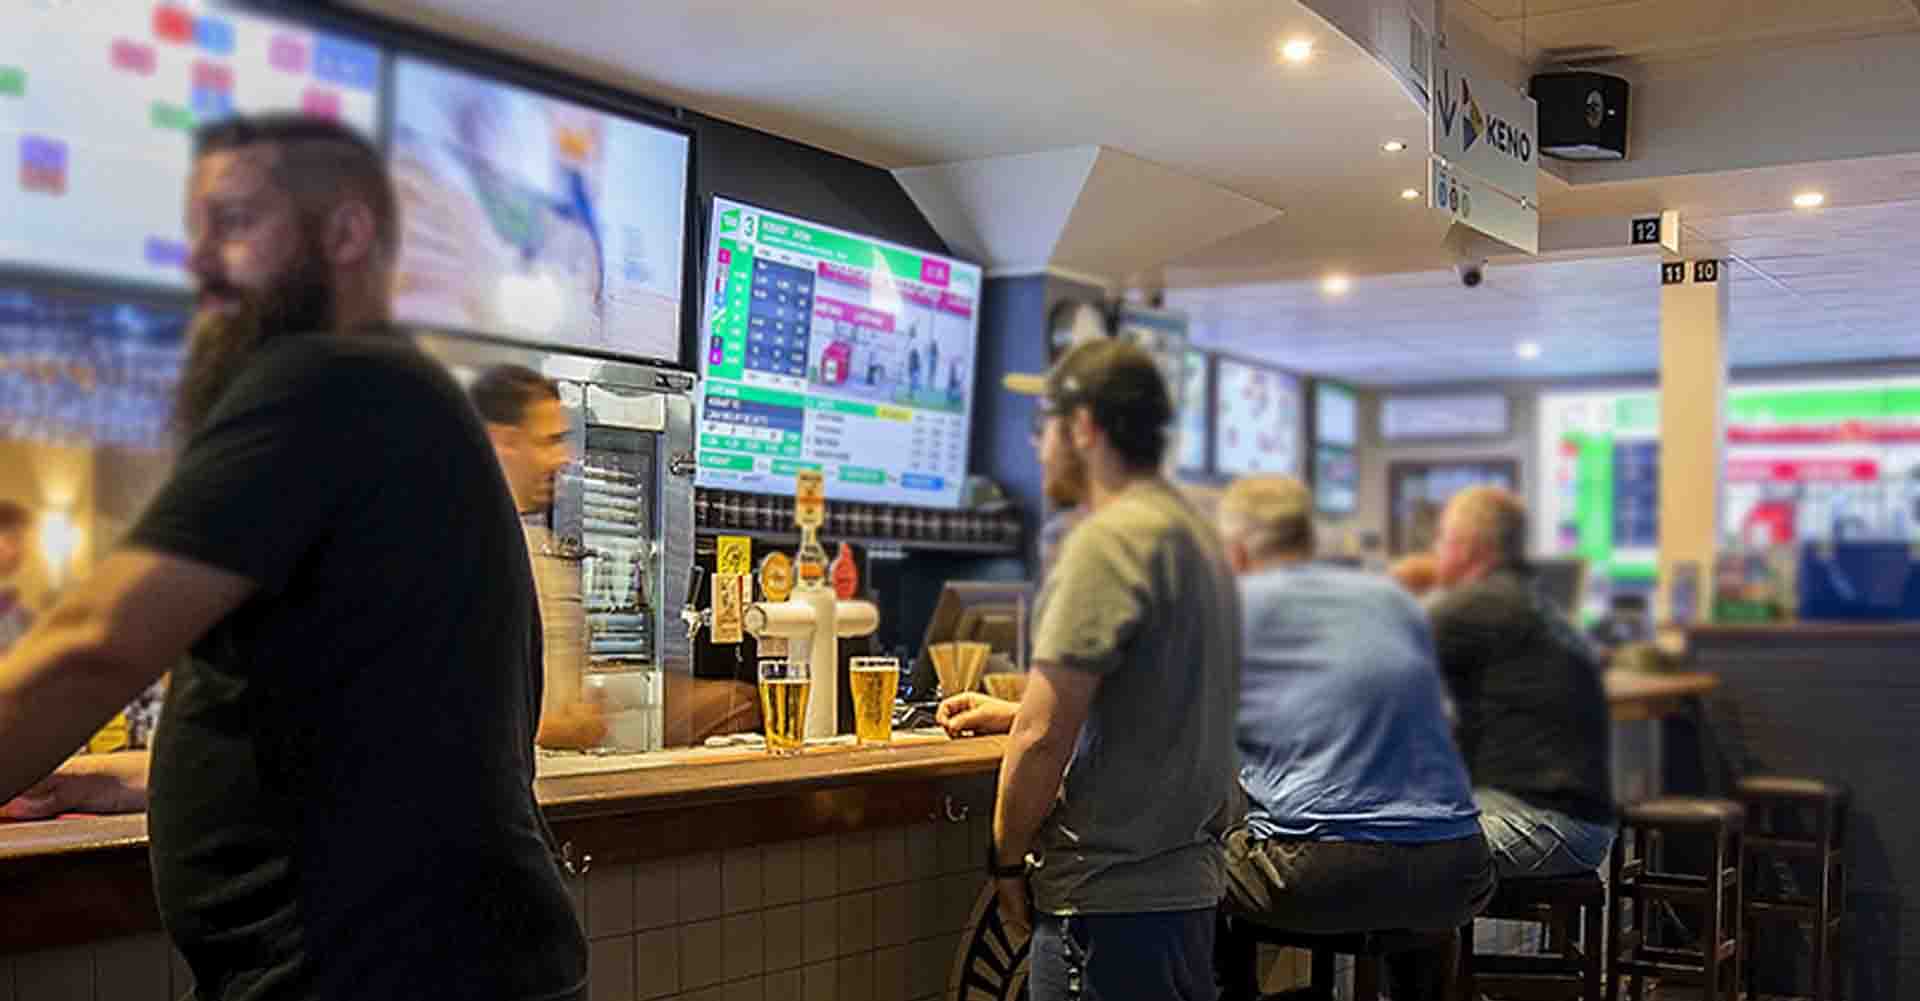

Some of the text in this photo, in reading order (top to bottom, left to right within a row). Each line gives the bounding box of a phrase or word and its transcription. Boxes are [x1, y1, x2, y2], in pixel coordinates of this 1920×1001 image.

[1486, 114, 1530, 162] KENO
[1636, 221, 1657, 240] 12
[1665, 265, 1682, 281] 11
[1697, 262, 1715, 280] 10
